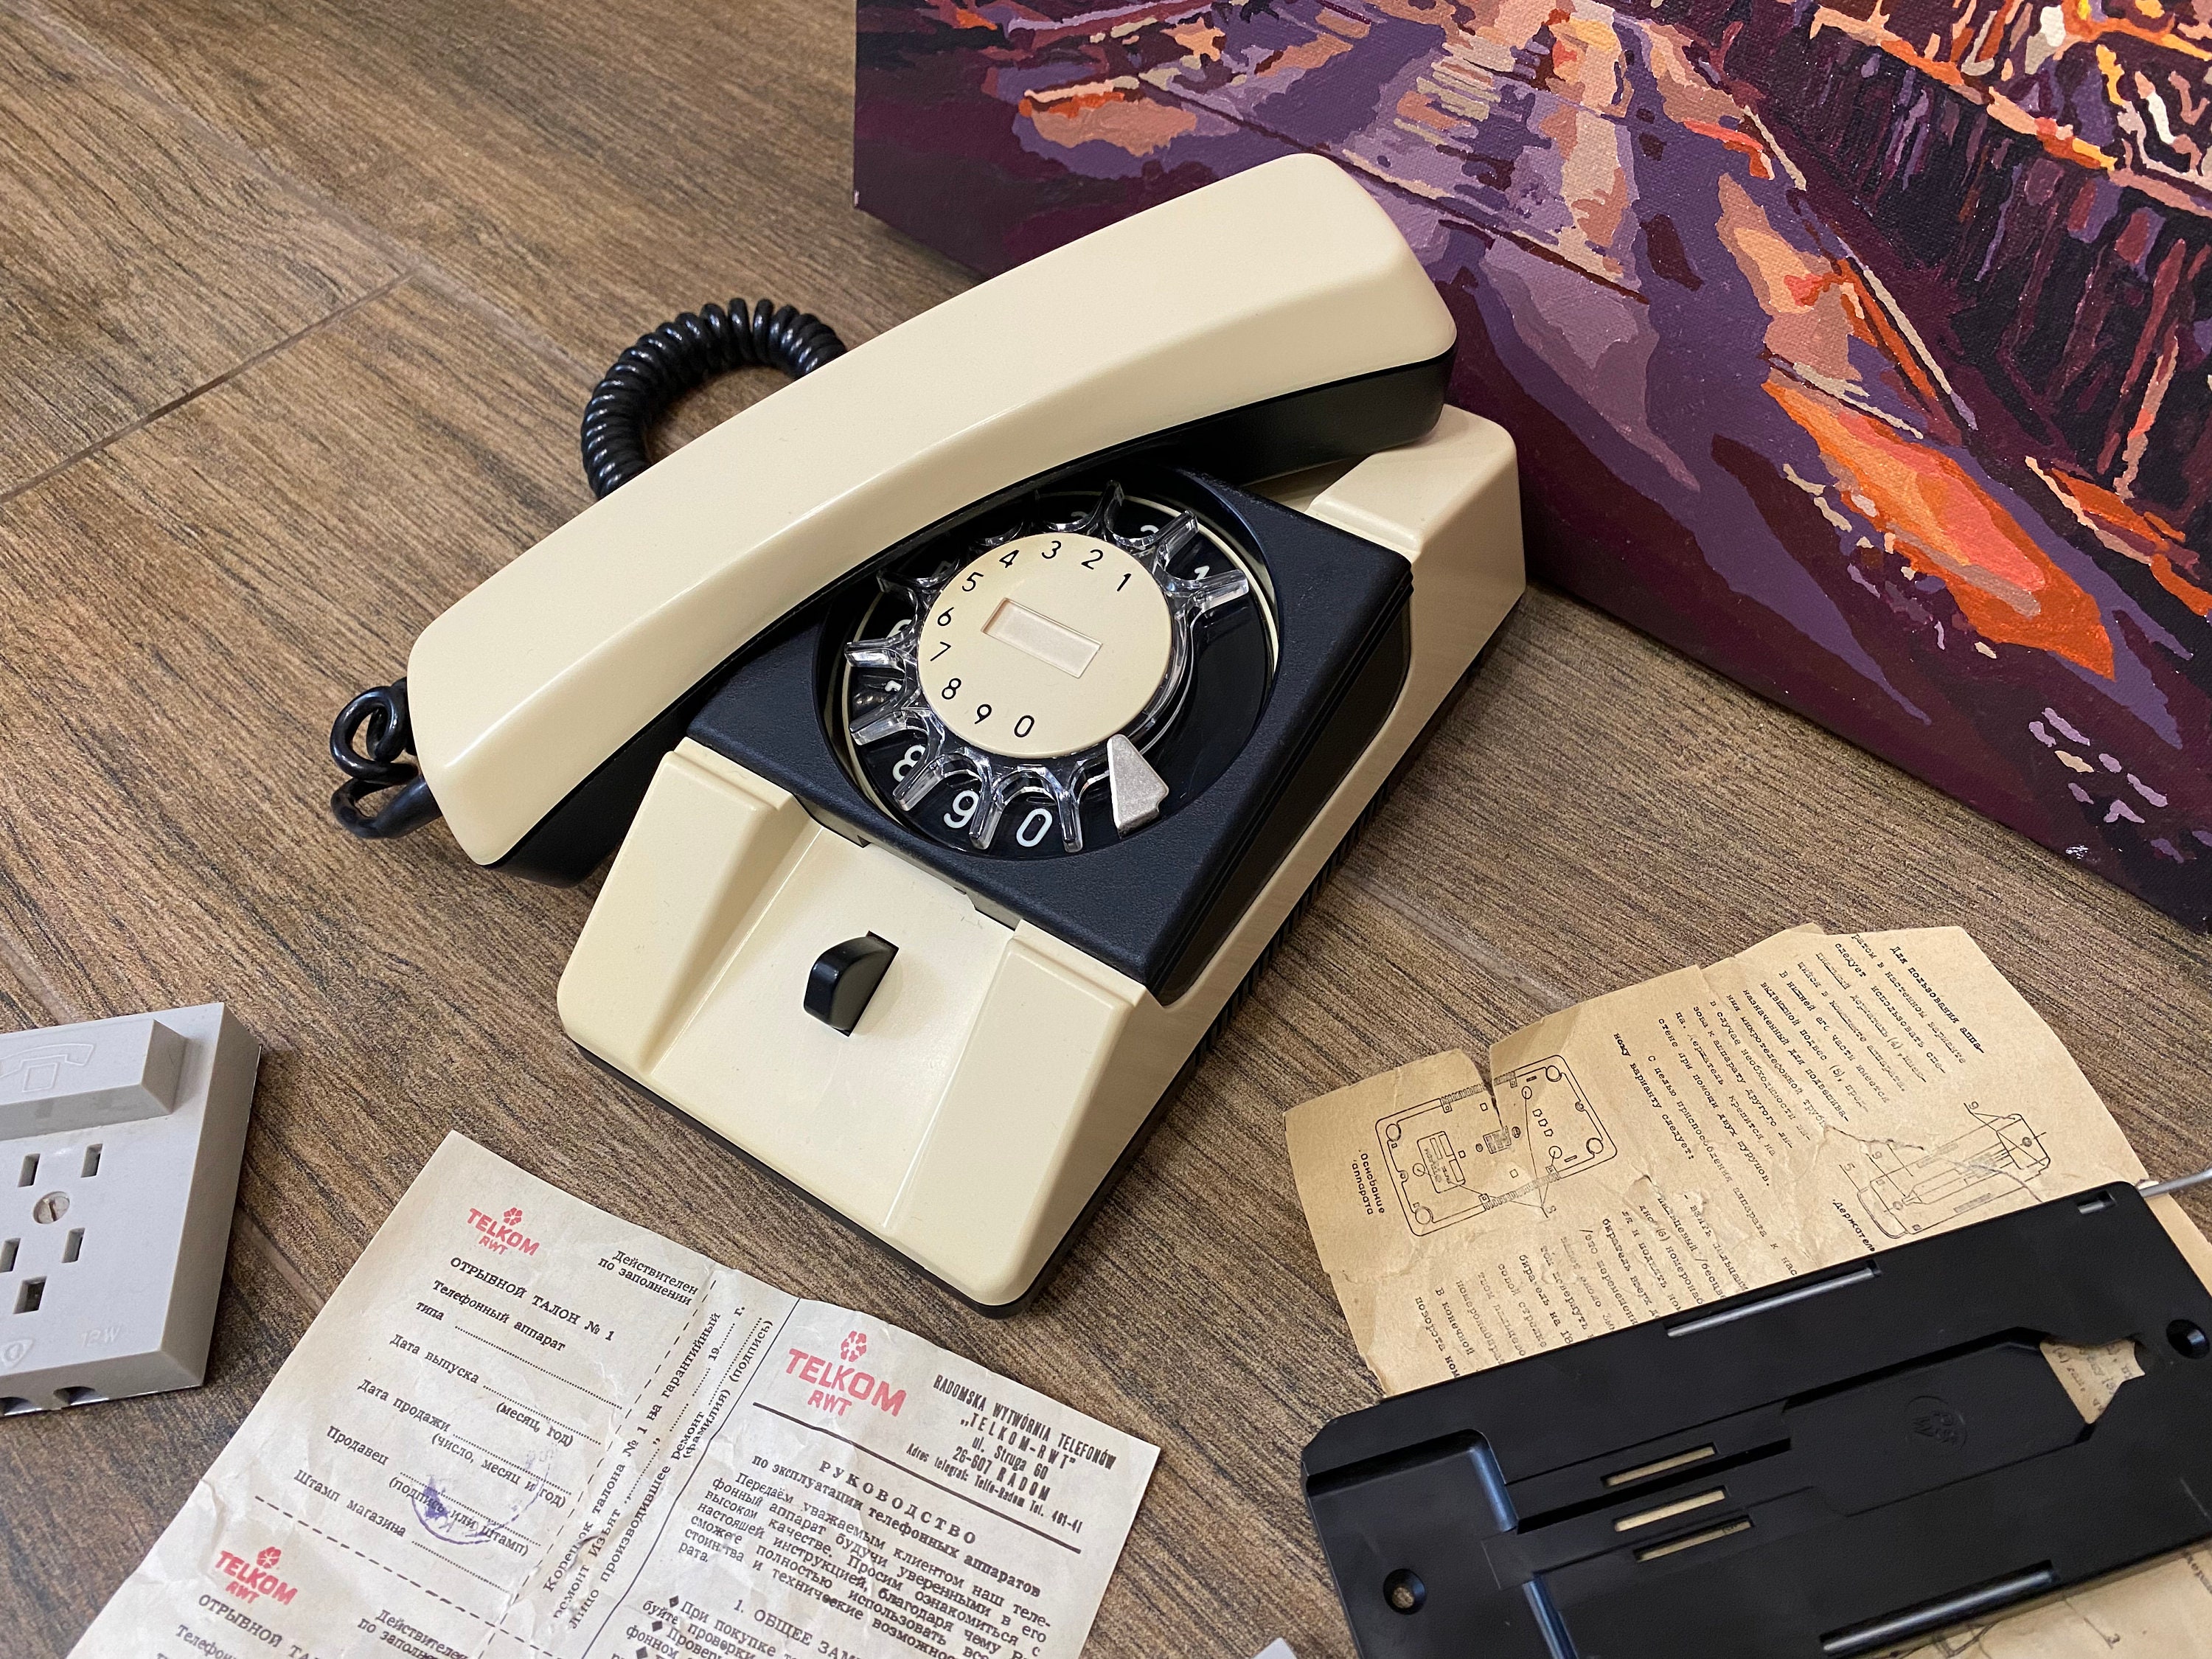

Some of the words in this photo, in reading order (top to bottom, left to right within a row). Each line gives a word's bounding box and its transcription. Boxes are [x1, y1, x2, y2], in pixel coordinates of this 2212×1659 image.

[998, 549, 1020, 568] 4
[1041, 540, 1062, 559] 3
[1081, 549, 1104, 570] 2
[961, 571, 984, 591] 5
[1116, 573, 1132, 591] 1
[937, 607, 954, 626] 6
[930, 641, 951, 661] 7
[942, 678, 961, 700] 8
[974, 703, 992, 724] 9
[1014, 714, 1034, 737] 0
[892, 745, 926, 782] 8
[943, 790, 980, 828] 9
[1016, 808, 1053, 846] 0
[1889, 946, 1908, 964] Для
[1968, 1101, 1980, 1110] 9
[1352, 1163, 1374, 1215] аппарата
[1843, 1162, 1856, 1172] 5
[467, 1207, 540, 1256] TELKOM
[478, 1235, 509, 1256] RWT
[1832, 1202, 1876, 1252] Держатель
[597, 1257, 615, 1271] по
[618, 1267, 692, 1306] заполнении
[611, 1250, 699, 1295] Действителен
[415, 1301, 445, 1321] типа
[432, 1279, 510, 1324] Телефонный
[513, 1321, 566, 1352] аппарат
[450, 1256, 528, 1299] ОТРЫВНОЙ
[531, 1295, 582, 1326] ТАЛОН
[583, 1320, 601, 1335] №
[605, 1330, 615, 1341] 1
[389, 1333, 420, 1355] Дата
[424, 1351, 479, 1384] выпуска
[785, 1347, 907, 1417] TELKOM
[356, 1379, 389, 1402] Дата
[392, 1397, 451, 1433] продажи
[682, 1389, 731, 1458] (фамилия)
[728, 1320, 773, 1382] (подпись)
[807, 1389, 853, 1417] RWT
[495, 1402, 540, 1433] (месяц,
[546, 1425, 574, 1447] год)
[588, 1509, 621, 1558] Изъят
[733, 1306, 745, 1317] г.
[591, 1464, 626, 1514] талона
[622, 1439, 639, 1458] №
[636, 1426, 648, 1435] 1
[645, 1404, 663, 1421] на
[661, 1312, 721, 1399] гарантийный
[933, 1374, 987, 1412] RADOMSKA
[992, 1402, 1051, 1442] WYTWÓRNIA
[1057, 1432, 1117, 1470] TELEFONÓW
[327, 1425, 389, 1466] Продавец
[971, 1436, 985, 1453] ul.
[993, 1444, 1027, 1472] Struga
[1033, 1462, 1049, 1481] 60
[431, 1433, 474, 1464] (число,
[480, 1459, 521, 1486] месяц
[538, 1488, 566, 1509] год)
[905, 1442, 930, 1463] Adres
[1029, 1499, 1044, 1517] Tel.
[951, 1445, 993, 1475] 26-607
[995, 1466, 1051, 1502] RADOM
[293, 1469, 341, 1502] Штамп
[346, 1499, 406, 1537] магазина
[600, 1466, 671, 1582] производившее
[670, 1411, 705, 1461] ремонт
[818, 1460, 976, 1545] РУКОВОДСТВО
[450, 1509, 479, 1531] или
[477, 1523, 529, 1557] штамп)
[734, 1472, 794, 1504] Передаём
[892, 1547, 965, 1589] клиентом
[971, 1584, 1006, 1607] наш
[1012, 1603, 1051, 1627] теле-
[751, 1455, 769, 1469] по
[771, 1464, 864, 1512] эксплуатации
[867, 1506, 960, 1559] телефонных
[963, 1554, 1041, 1598] аппаратов
[678, 1542, 709, 1563] рата.
[704, 1487, 759, 1520] высоком
[768, 1518, 832, 1558] качестве.
[846, 1554, 904, 1592] Просим
[914, 1587, 1020, 1647] ознакомиться
[1032, 1646, 1041, 1658] с
[712, 1477, 764, 1507] фонный
[768, 1503, 827, 1535] аппарат
[835, 1532, 888, 1568] будучи
[896, 1565, 992, 1618] уверенными
[1000, 1614, 1012, 1627] в
[1021, 1625, 1047, 1643] его
[751, 1559, 764, 1572] и
[215, 1550, 299, 1606] TELKOM
[224, 1580, 260, 1604] RWT
[755, 1545, 833, 1589] полностью
[847, 1589, 947, 1646] использовать
[772, 1537, 868, 1593] инструкцией,
[877, 1587, 955, 1633] благодаря
[964, 1629, 1002, 1655] чему
[198, 1595, 282, 1648] ОТРЫВНОЙ
[358, 1618, 377, 1633] по
[642, 1600, 679, 1625] буйте
[680, 1600, 710, 1624] При
[713, 1618, 776, 1658] покупке
[733, 1599, 744, 1613] 1.
[754, 1609, 813, 1646] ОБЩЕЕ
